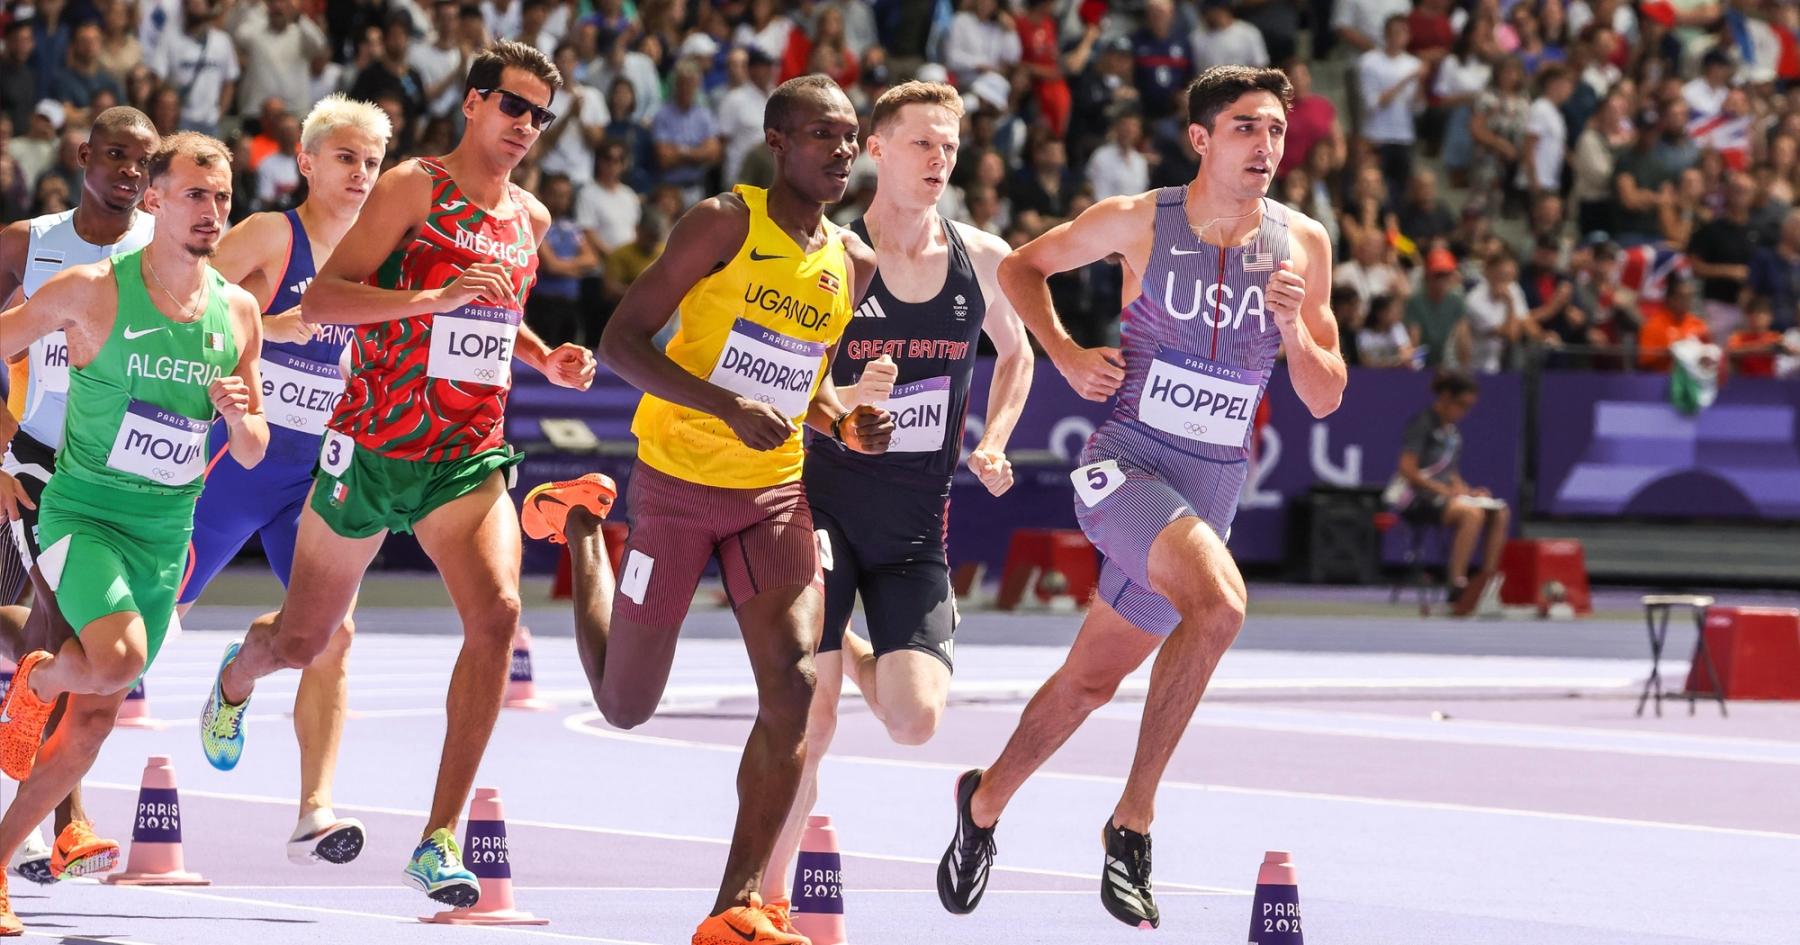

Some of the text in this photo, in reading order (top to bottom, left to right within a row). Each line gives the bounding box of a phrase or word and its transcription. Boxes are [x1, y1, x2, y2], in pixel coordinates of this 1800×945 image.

[455, 229, 529, 268] MÉXICO
[464, 307, 491, 318] PARIS
[1165, 271, 1267, 333] USA
[762, 331, 790, 347] PARIS
[848, 339, 969, 361] GREAT BRITAIN
[126, 353, 222, 387] ALGERIA
[288, 358, 315, 371] PARIS
[1185, 358, 1242, 380] PARIS 2024
[1150, 375, 1249, 421] HOPPEL
[157, 411, 185, 427] PARIS
[327, 439, 341, 467] 3
[1087, 466, 1108, 490] 5
[139, 803, 178, 817] PARIS
[138, 816, 178, 830] 2024
[1264, 918, 1302, 933] 202
